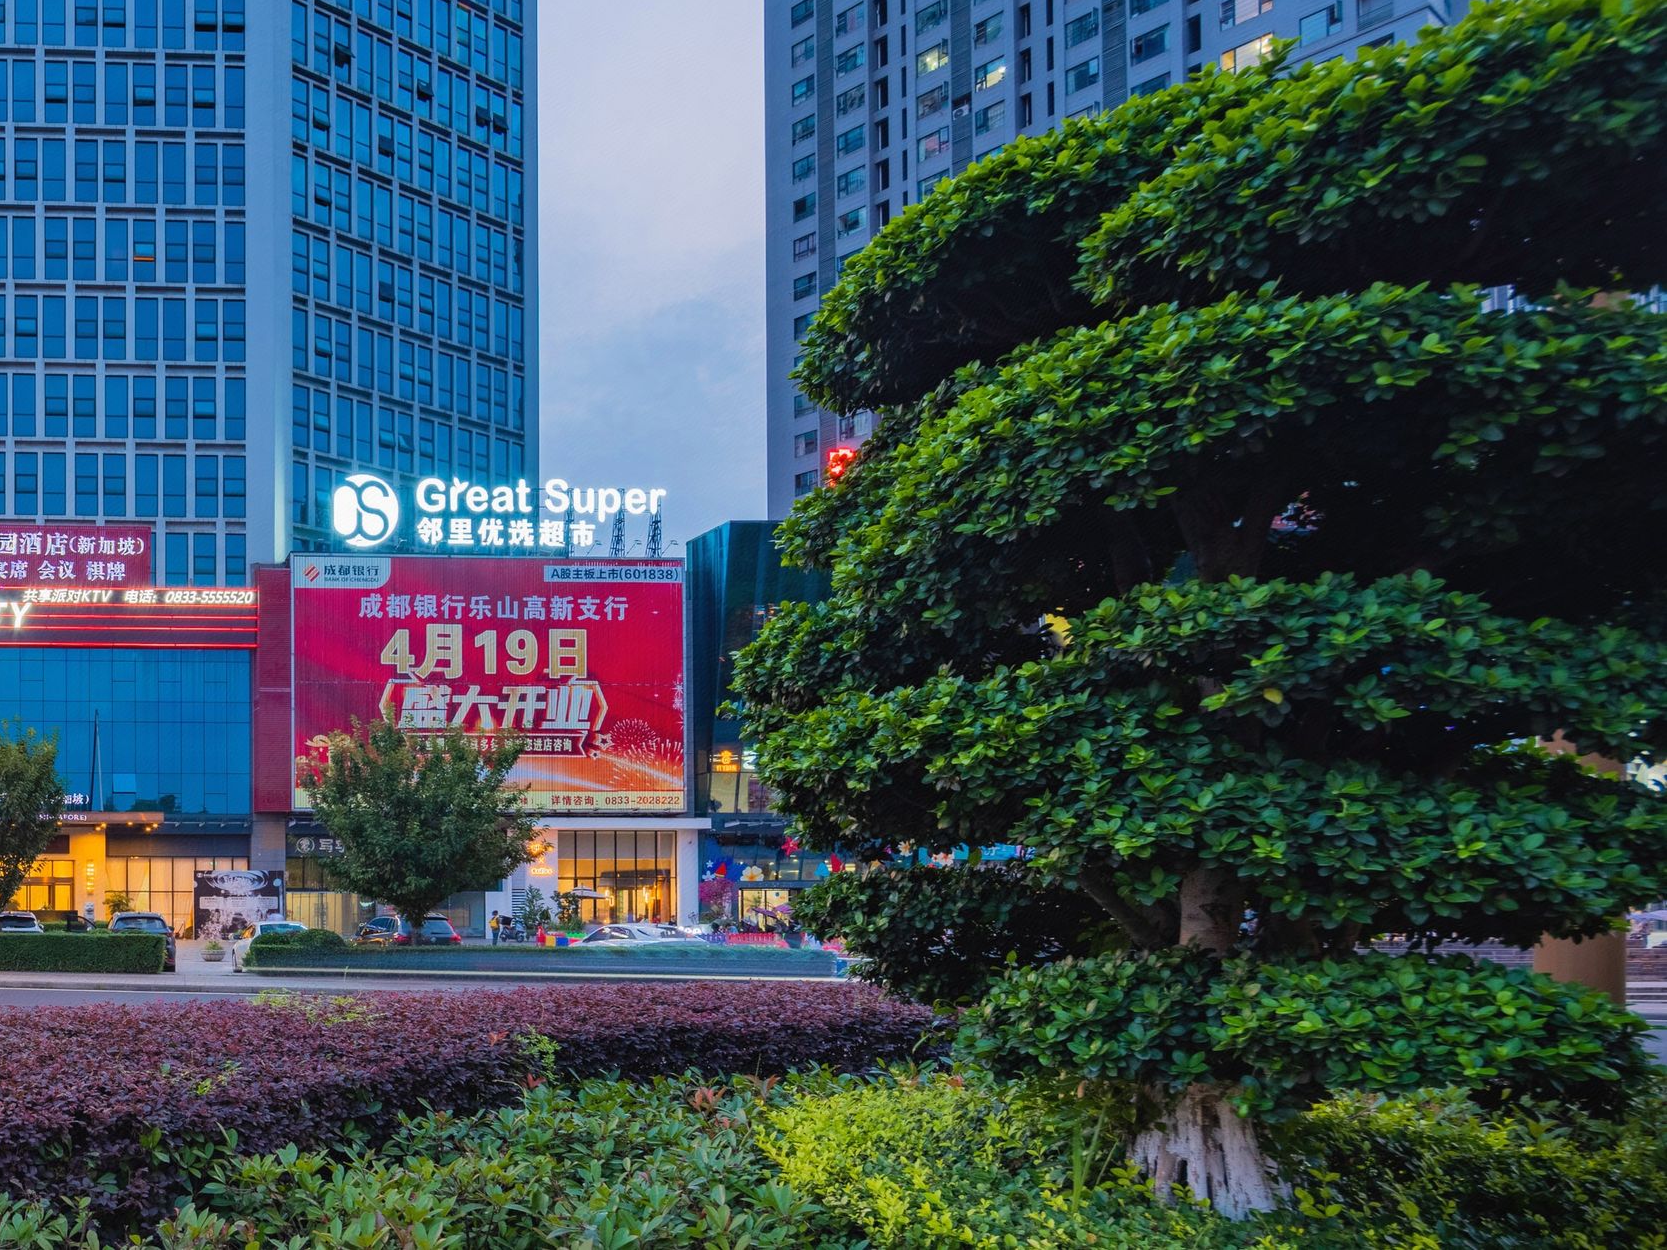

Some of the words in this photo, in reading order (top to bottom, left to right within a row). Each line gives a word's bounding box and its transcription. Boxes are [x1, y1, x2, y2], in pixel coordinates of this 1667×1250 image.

[416, 477, 533, 513] Great
[545, 478, 666, 522] Super
[417, 517, 596, 548] 邻里优选超市
[37, 560, 76, 579] 会议
[86, 561, 126, 581] 棋牌
[324, 565, 379, 576] 成都银行
[551, 568, 678, 580] A股主板上市(601838)
[23, 589, 112, 602] 共享派对KTV
[165, 591, 253, 604] 0833-5555520
[358, 594, 629, 621] 成都银行乐山高新支行
[380, 624, 587, 679] 4月19日
[397, 685, 593, 730] 盛大开业
[605, 796, 680, 806] 0833-2028222
